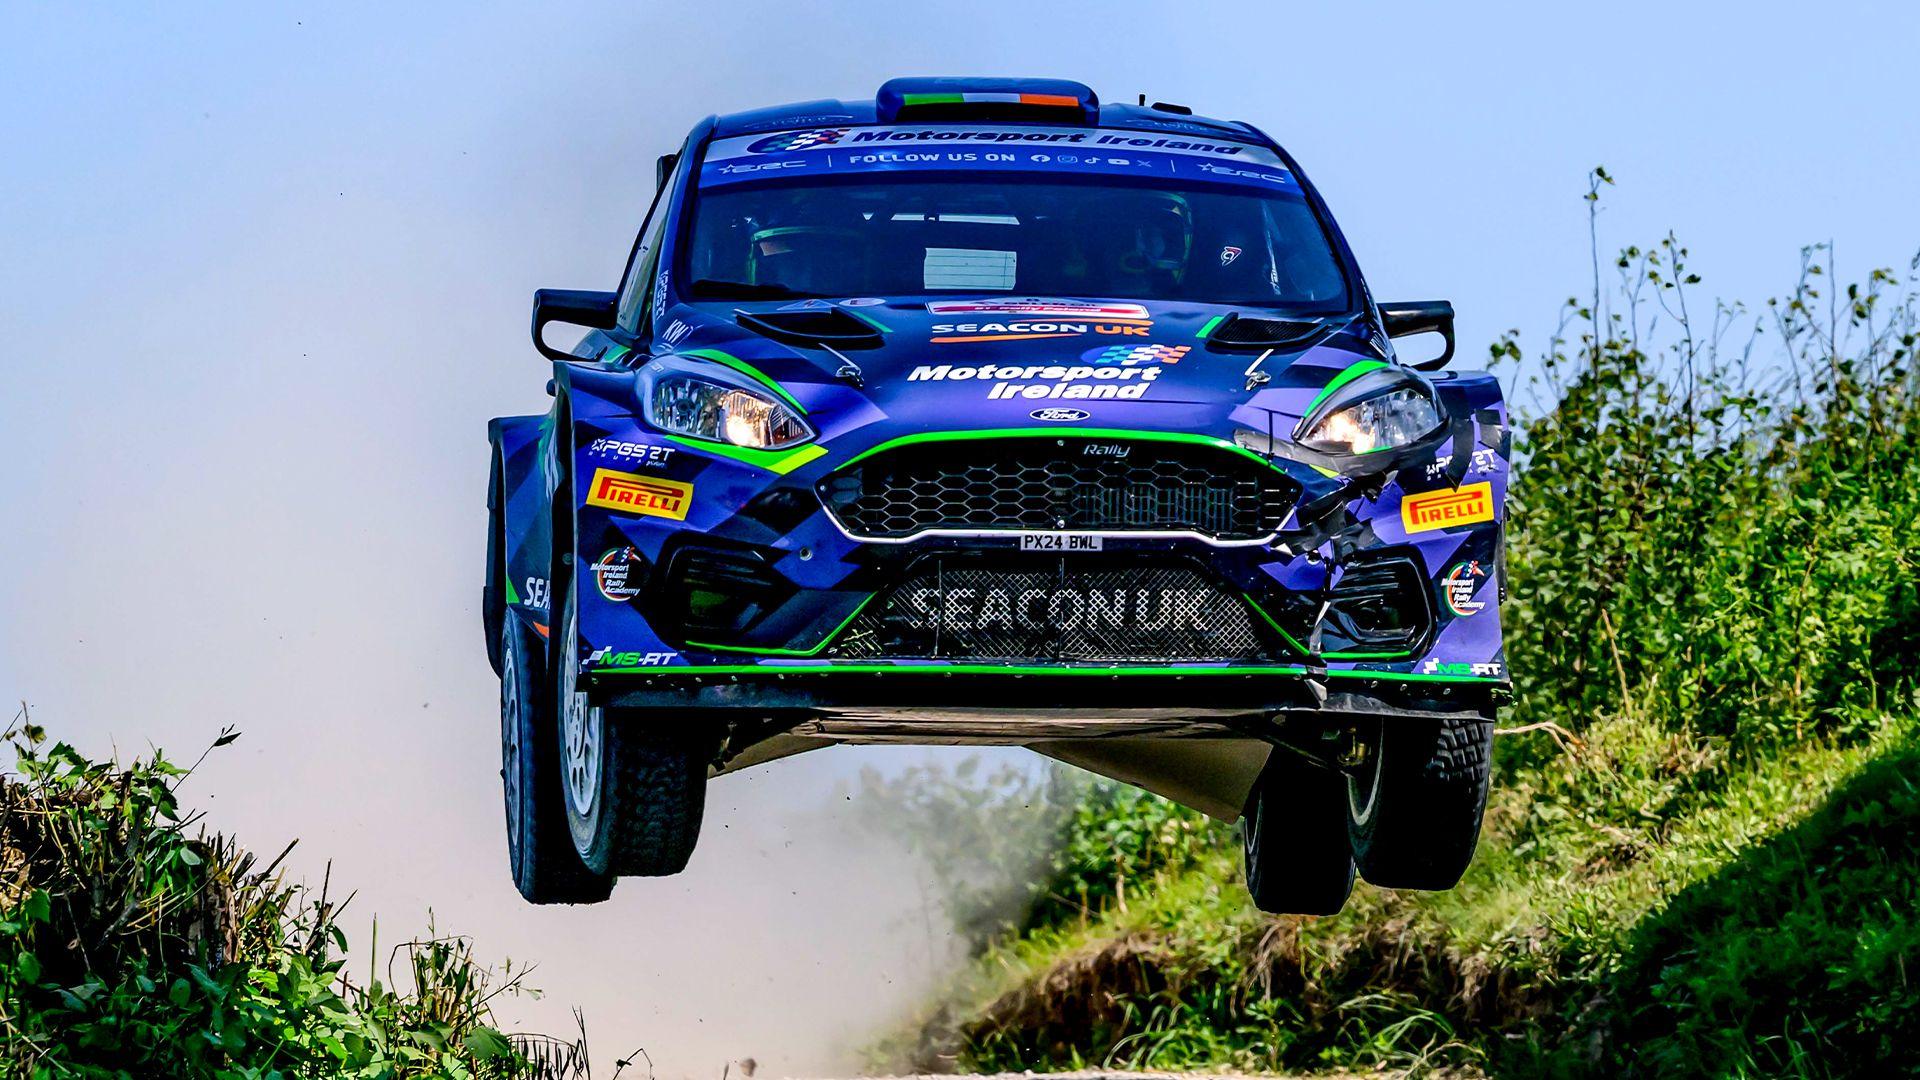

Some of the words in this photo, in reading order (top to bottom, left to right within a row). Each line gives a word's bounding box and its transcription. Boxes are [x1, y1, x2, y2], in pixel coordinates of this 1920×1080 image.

[852, 130, 1088, 145] Motorsport
[1096, 135, 1244, 155] Ireland
[850, 153, 940, 164] FOLLOW
[947, 153, 978, 162] US
[985, 153, 1015, 162] ON
[931, 323, 1088, 333] SEACON
[1094, 325, 1150, 336] UK
[907, 363, 1161, 384] Motorsport
[987, 381, 1151, 400] Ireland
[1037, 408, 1081, 422] Ford
[1083, 443, 1131, 458] Rally
[597, 476, 685, 512] PIRELLI
[1409, 491, 1484, 525] PIRELLI
[1024, 534, 1063, 549] PX24
[1068, 535, 1098, 549] BWL
[590, 563, 629, 573] Motorsport
[603, 571, 628, 579] Ireland
[605, 579, 626, 588] Rally
[604, 587, 641, 596] Academy
[911, 588, 1125, 630] SEACON
[1136, 588, 1210, 630] UK
[599, 651, 678, 666] MS-RT
[1437, 662, 1502, 675] MS-RT
